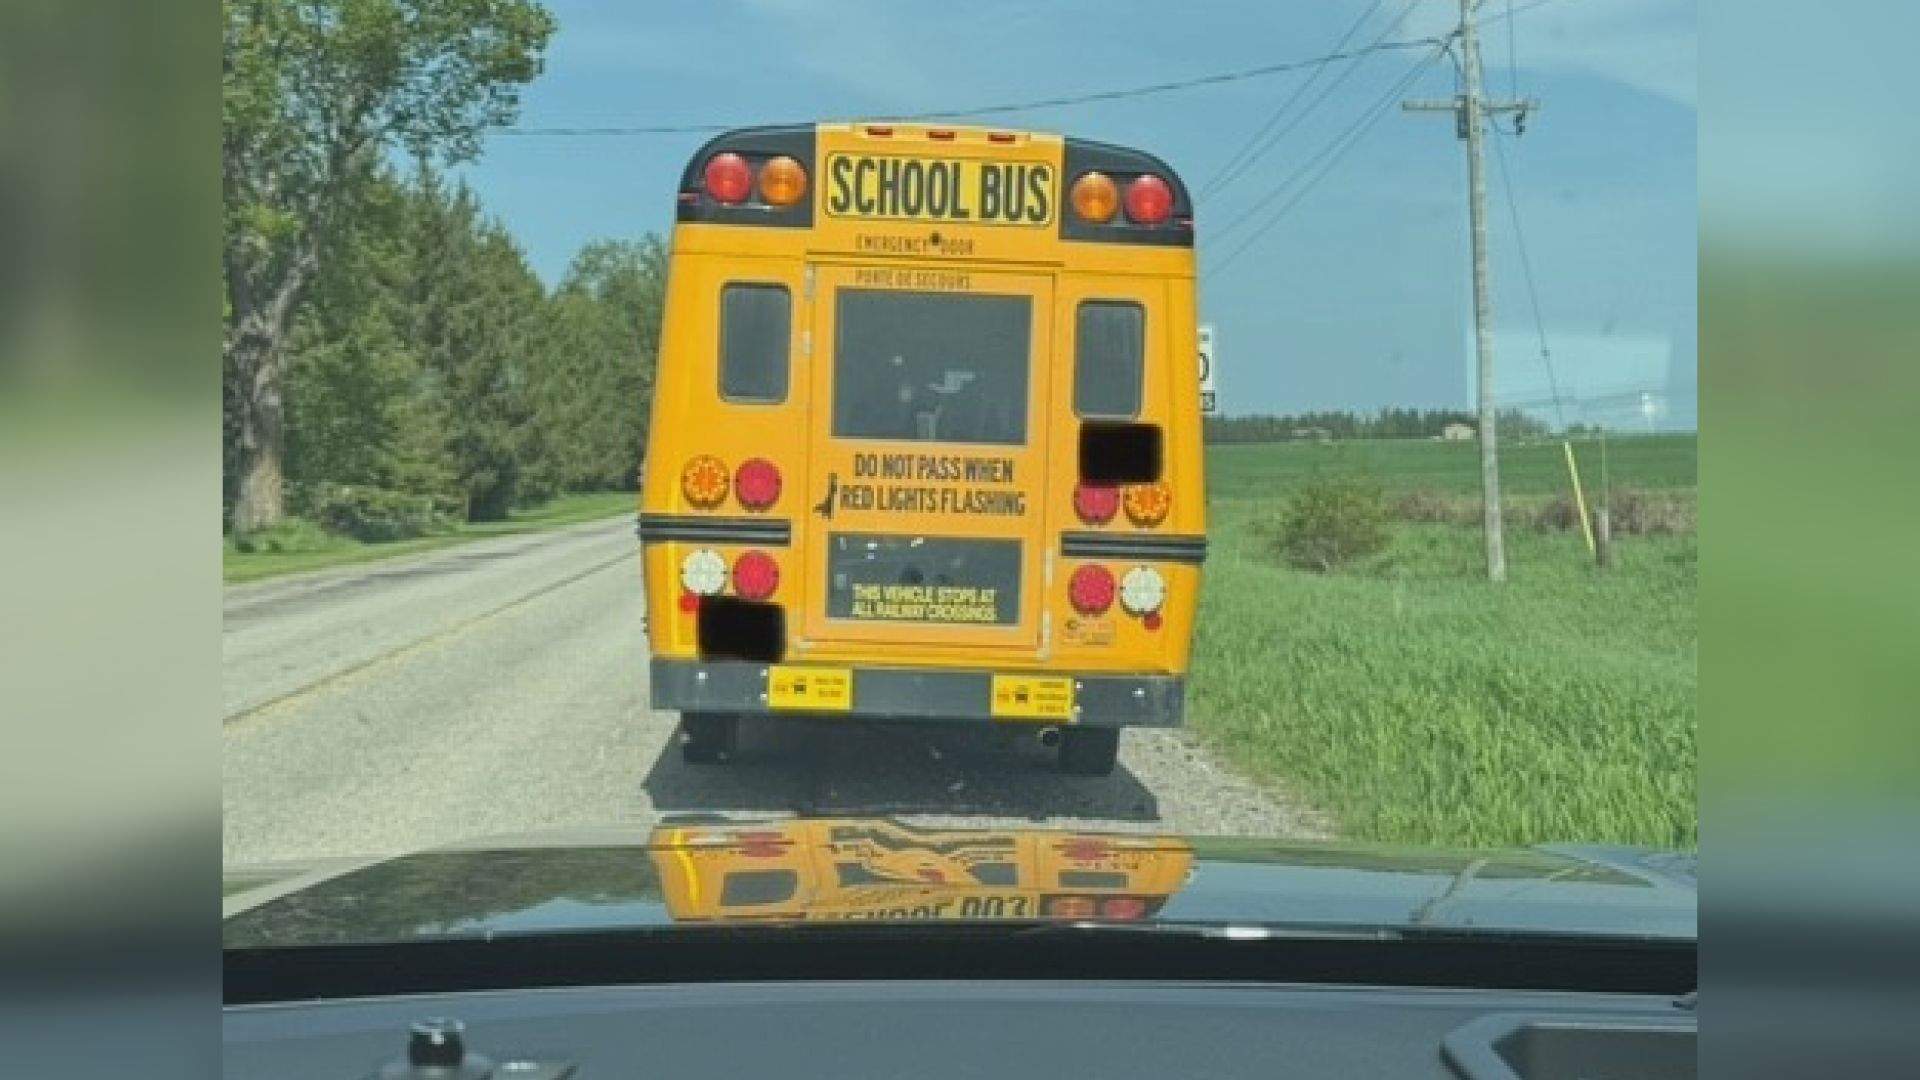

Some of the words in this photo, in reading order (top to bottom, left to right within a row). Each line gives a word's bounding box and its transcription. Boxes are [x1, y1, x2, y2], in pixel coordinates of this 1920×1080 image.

[830, 155, 970, 219] SCHOOL
[979, 162, 1050, 222] BUS
[854, 453, 878, 477] DO
[882, 454, 914, 479] NOT
[916, 455, 961, 480] PASS
[965, 457, 1014, 482] WHEN
[839, 484, 875, 510] RED
[876, 485, 936, 513] LIGHTS
[941, 487, 1026, 516] FLASHING
